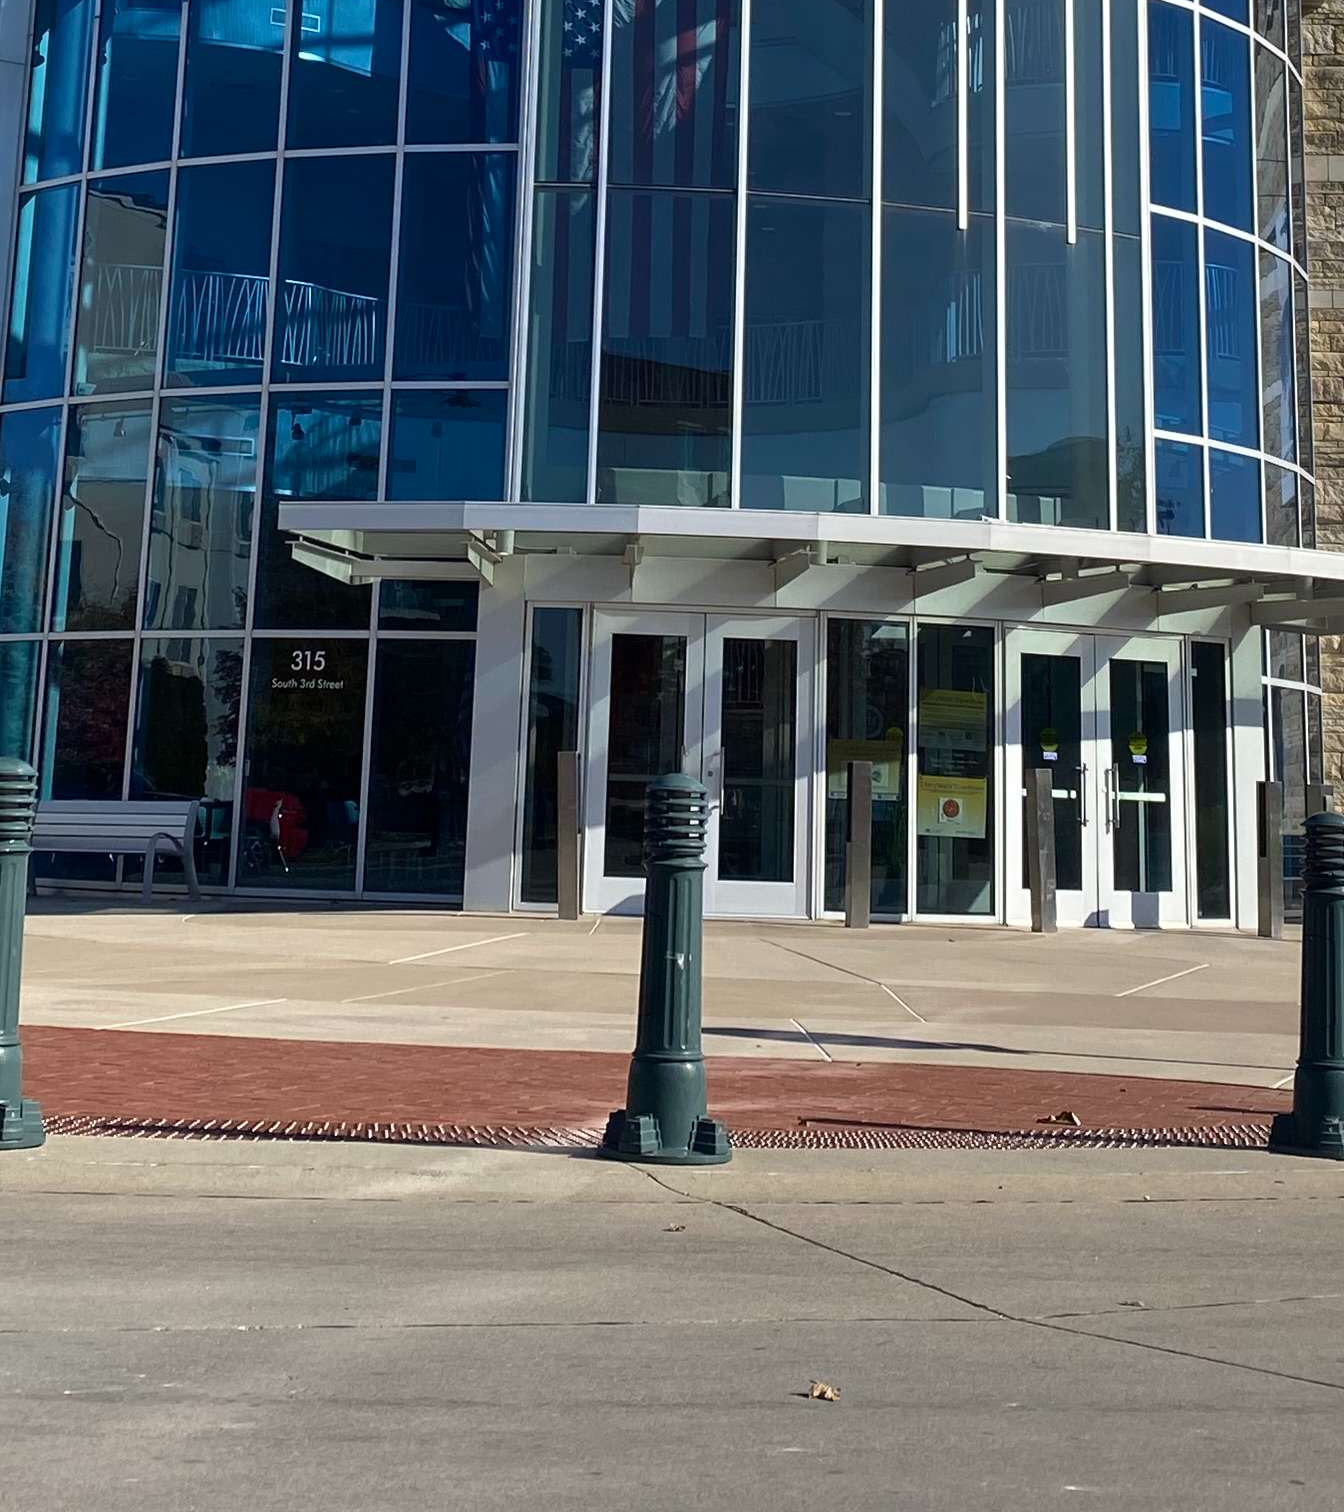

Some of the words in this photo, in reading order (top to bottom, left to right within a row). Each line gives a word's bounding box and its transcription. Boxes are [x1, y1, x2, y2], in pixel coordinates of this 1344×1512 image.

[291, 650, 326, 671] 315
[272, 678, 297, 688] South
[300, 678, 315, 688] 3rd
[317, 679, 343, 689] Street
